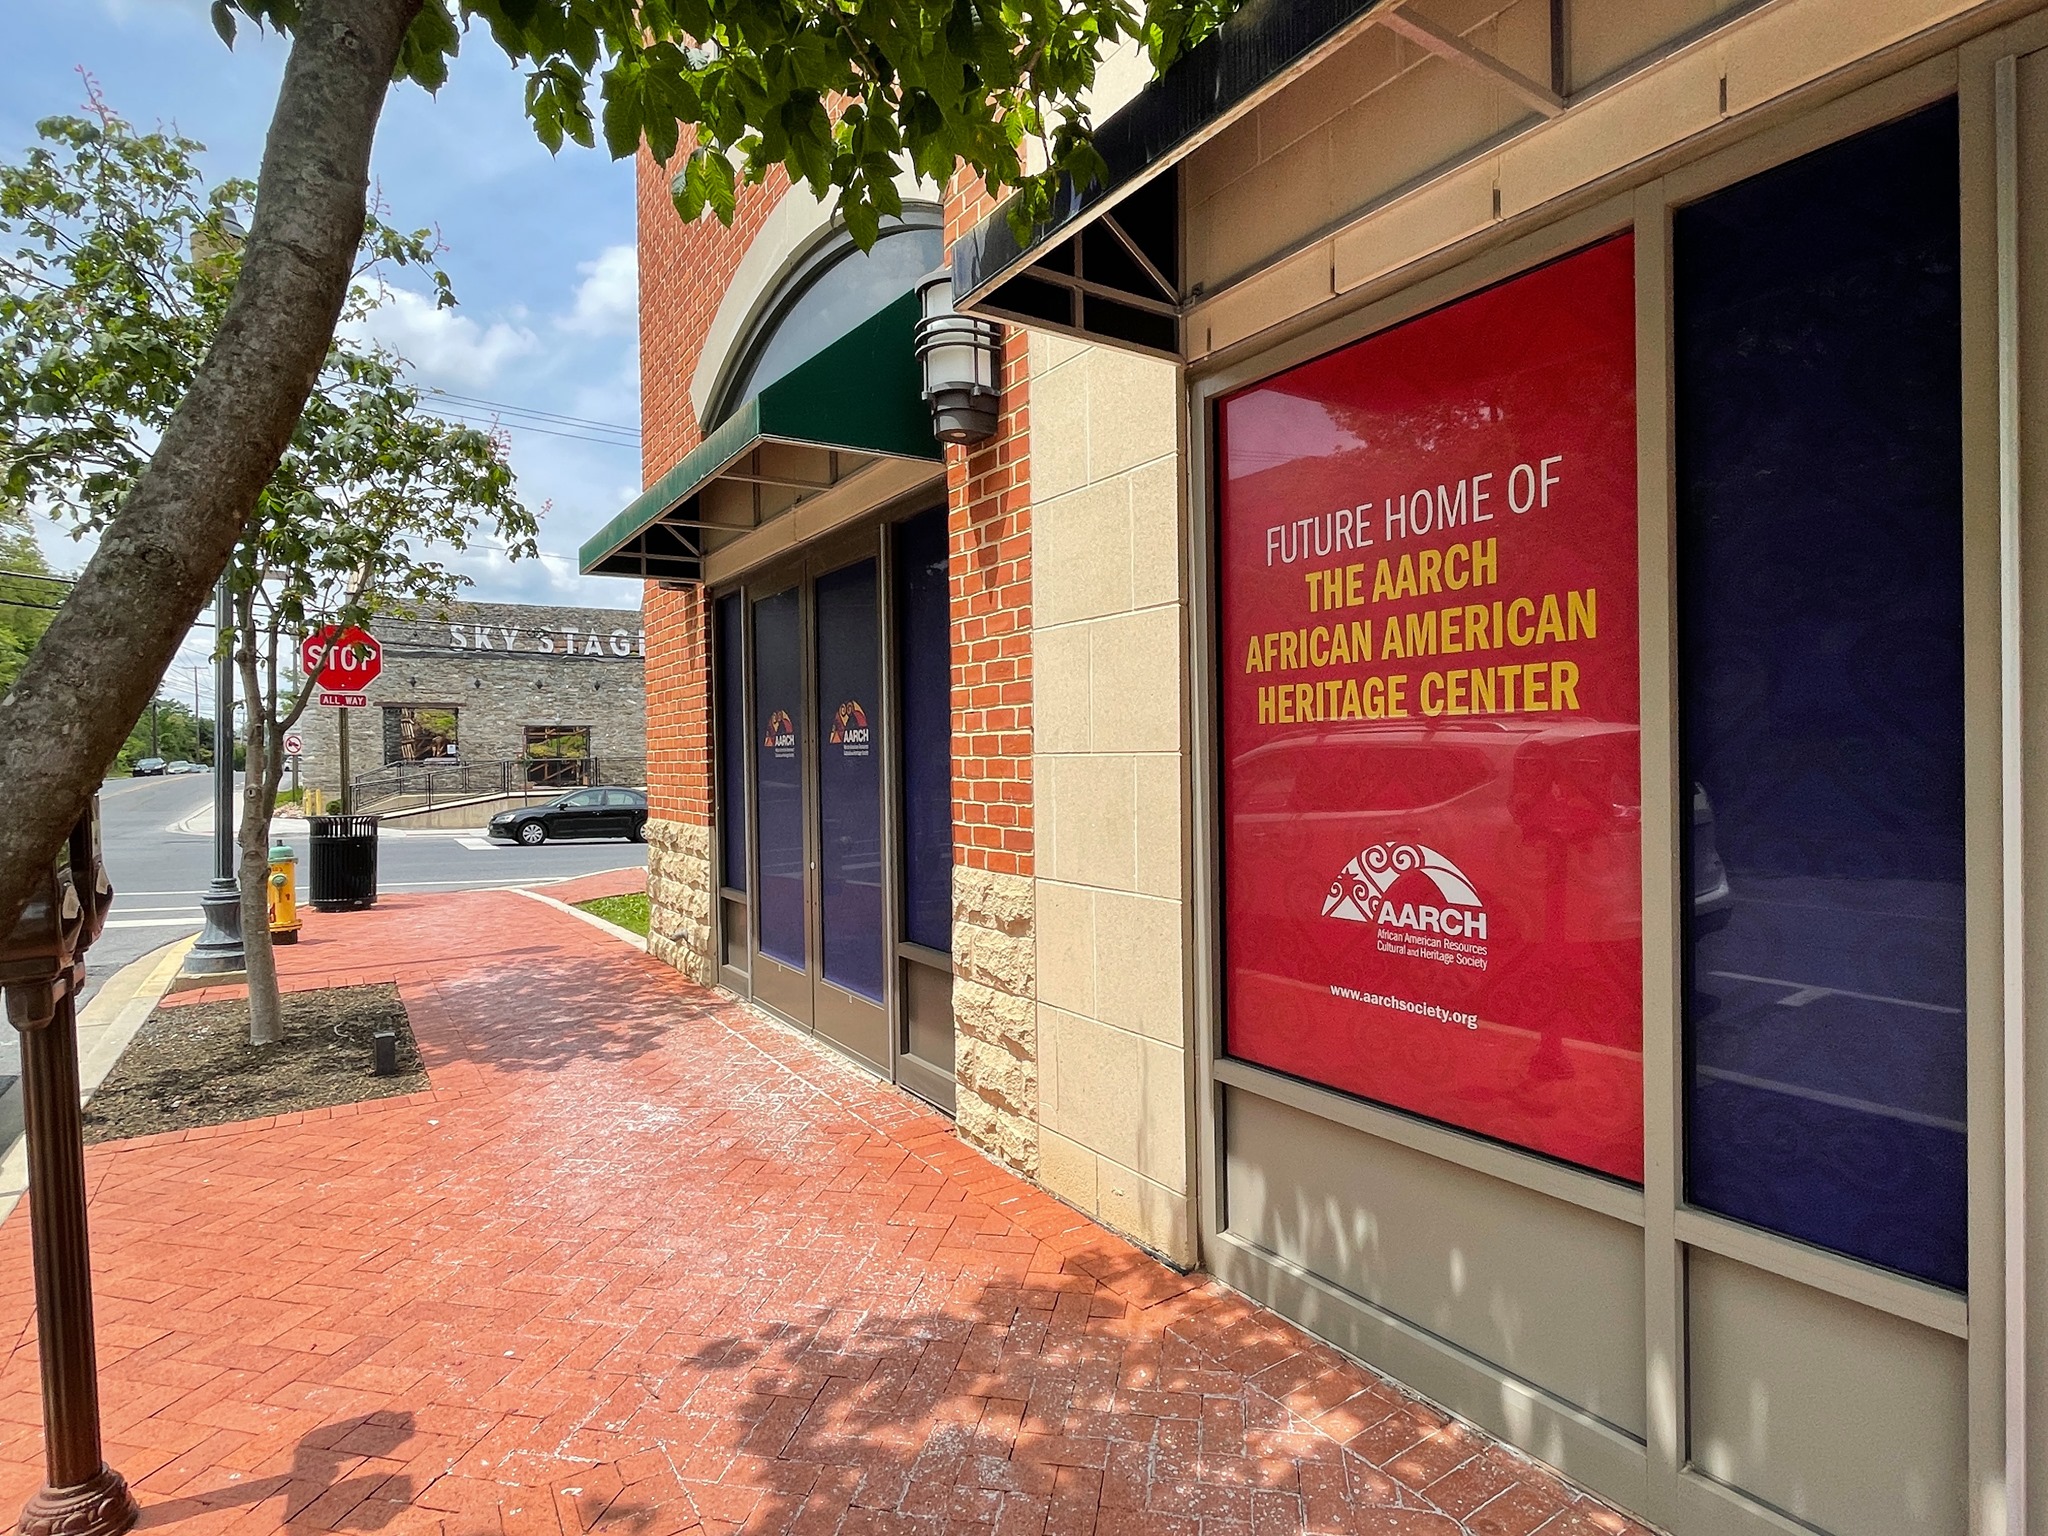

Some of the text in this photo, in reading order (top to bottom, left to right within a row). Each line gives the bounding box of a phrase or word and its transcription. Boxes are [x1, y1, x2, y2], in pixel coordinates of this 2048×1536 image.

[1267, 455, 1562, 566] FUTURE HOME OF
[1305, 537, 1497, 612] THE AARCH
[450, 624, 519, 651] SKY
[1246, 589, 1597, 674] AFRICAN AMERICAN
[307, 645, 377, 671] STOP
[322, 695, 364, 706] ALL WAY
[1258, 661, 1580, 725] HERITAGE CENTER
[775, 734, 795, 746] AARCH
[844, 729, 869, 743] AARCH
[1378, 900, 1487, 939] AARCH
[1377, 928, 1488, 956] African American Resources
[1377, 940, 1488, 972] Cultural and Heritage Society
[1330, 984, 1478, 1029] www.aarchsociety.org
